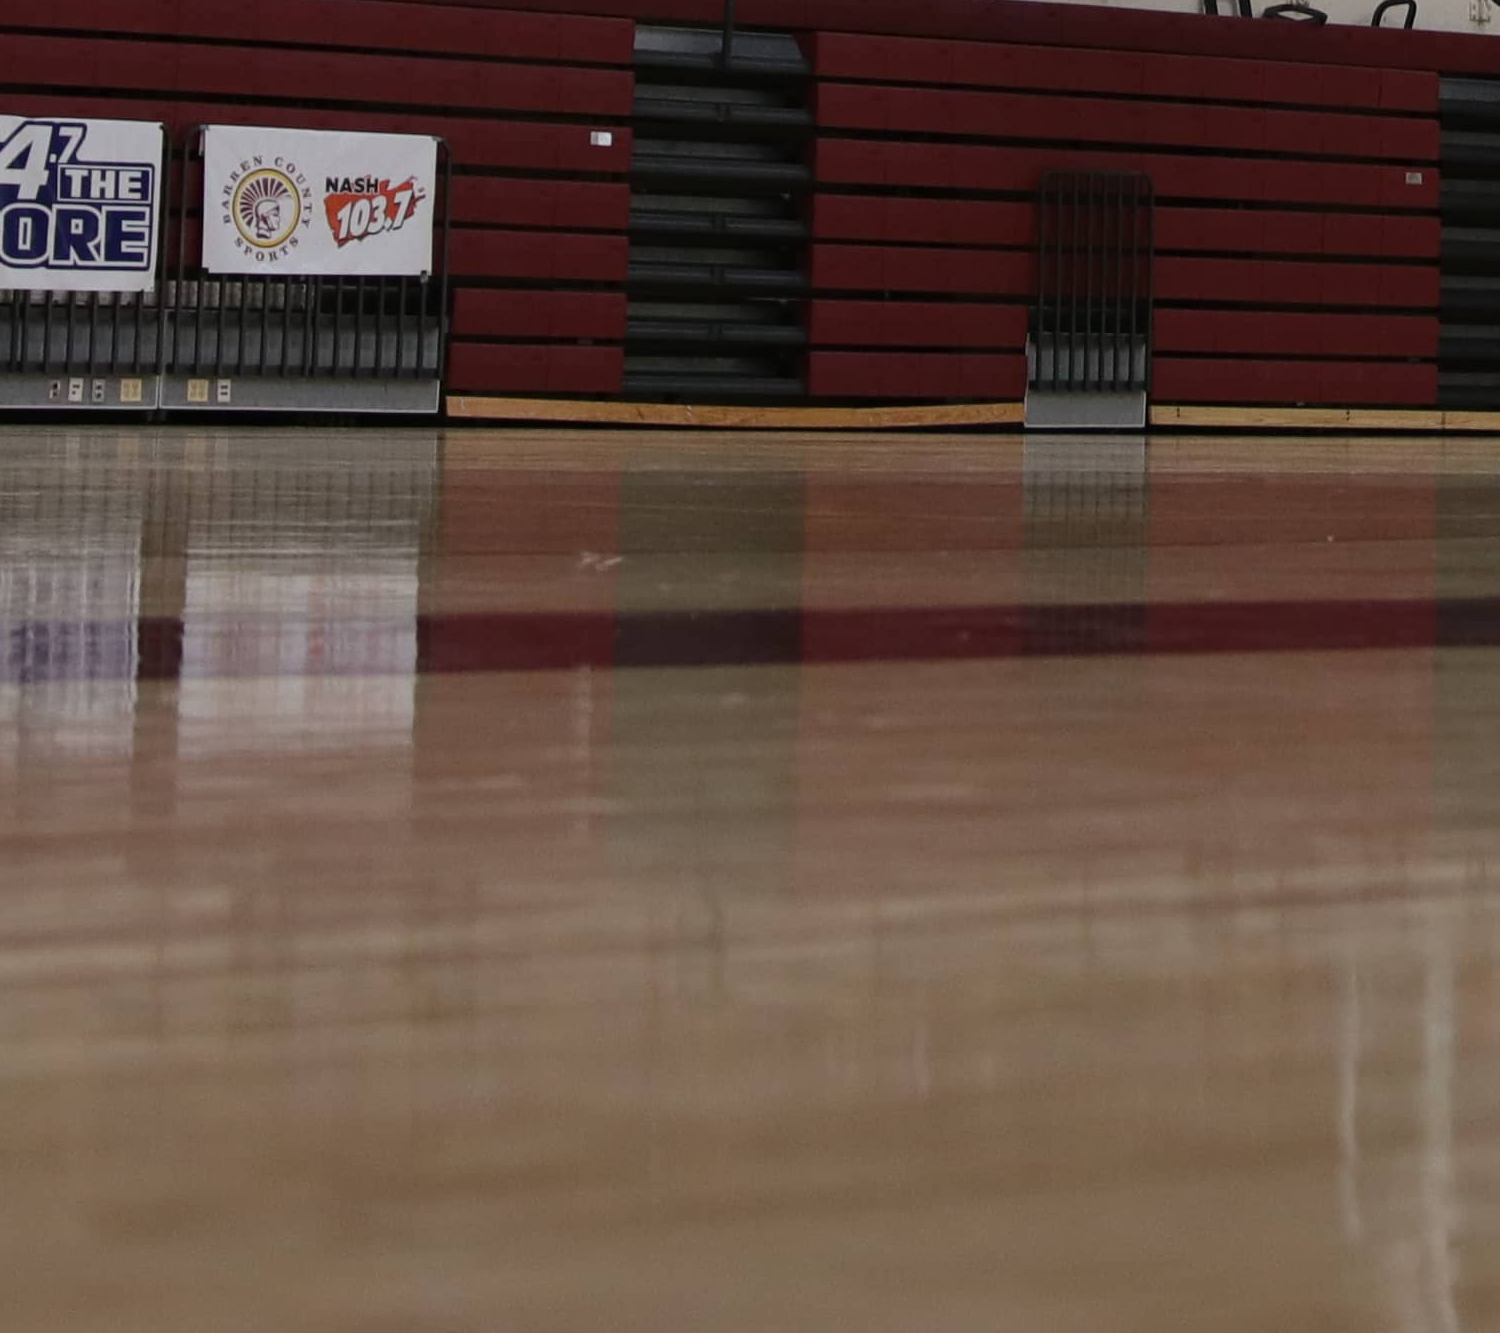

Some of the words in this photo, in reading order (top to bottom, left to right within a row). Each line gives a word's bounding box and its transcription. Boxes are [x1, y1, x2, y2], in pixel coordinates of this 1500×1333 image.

[62, 169, 144, 201] THE
[221, 156, 264, 225] BARREN
[283, 156, 313, 228] COUNTY
[325, 176, 380, 194] NASH
[337, 188, 417, 244] 103.7
[233, 235, 300, 262] SPORTS
